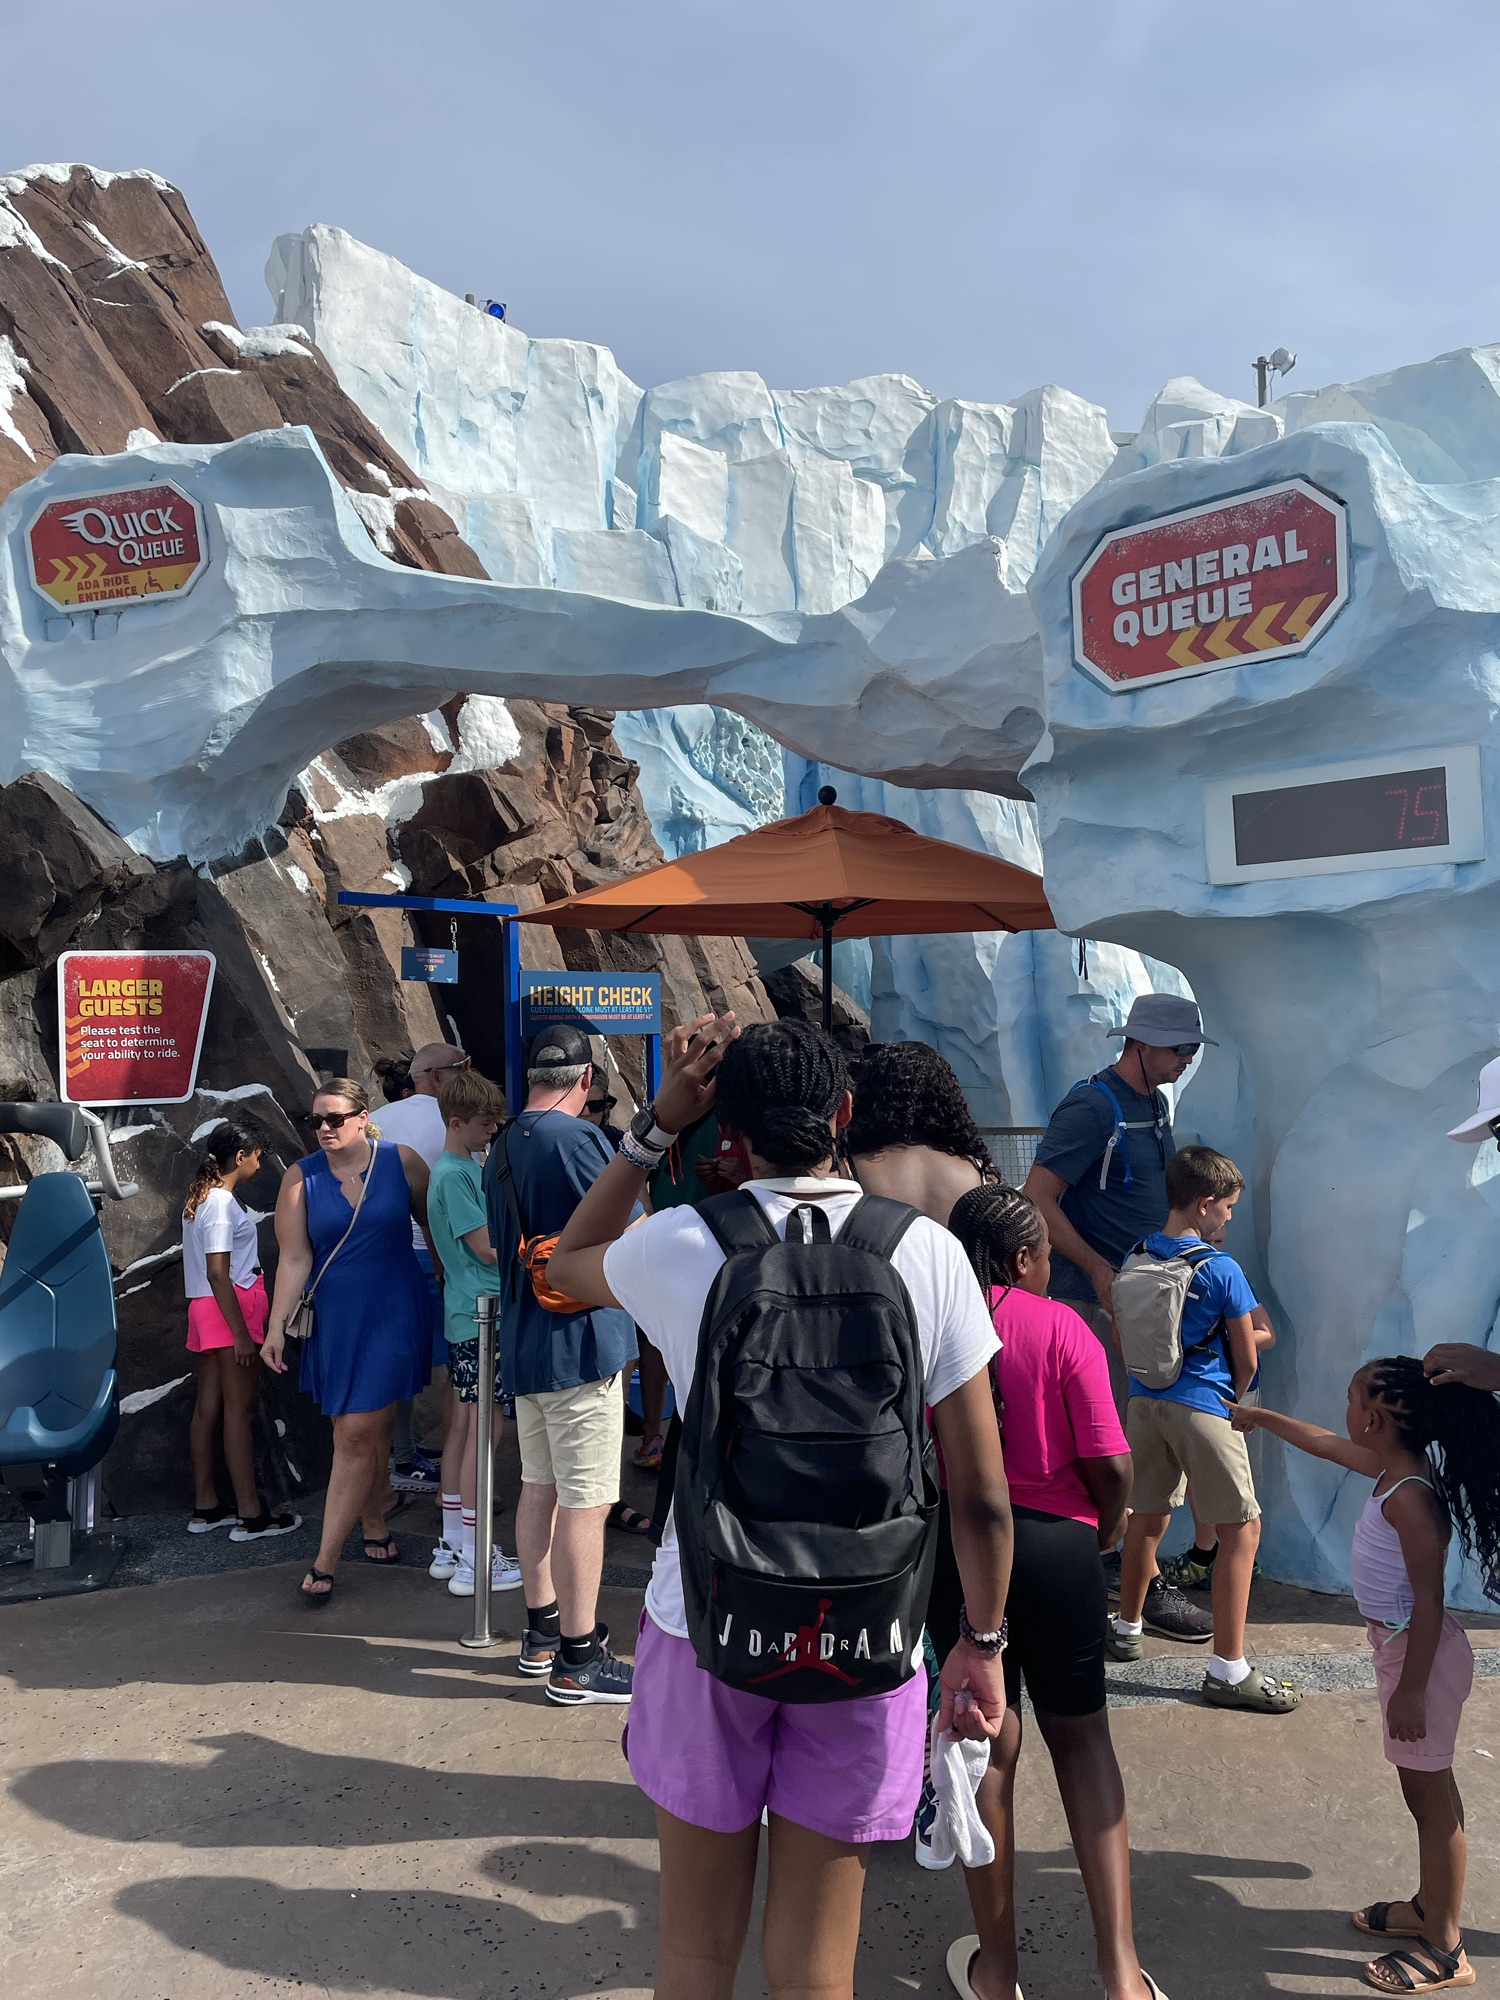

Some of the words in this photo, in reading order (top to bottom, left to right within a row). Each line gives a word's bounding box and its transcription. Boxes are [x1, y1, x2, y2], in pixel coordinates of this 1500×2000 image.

[118, 538, 185, 566] QUEUE
[1111, 529, 1308, 606] GENERAL
[77, 578, 100, 592] ADA
[103, 575, 130, 588] RIDE
[78, 586, 138, 604] ENTRANCE
[1113, 581, 1252, 647] QUEUE
[1384, 785, 1441, 841] 75
[78, 979, 163, 997] LARGER
[530, 986, 594, 1006] HEIGHT
[598, 986, 652, 1006] CHECK
[79, 998, 162, 1017] GUESTS
[530, 1006, 553, 1014] GUESTS
[80, 1026, 116, 1036] Please
[118, 1026, 140, 1035] test
[142, 1025, 160, 1034] the
[80, 1038, 104, 1048] seat
[107, 1038, 118, 1048] to
[120, 1037, 176, 1047] determine
[81, 1052, 106, 1062] your
[108, 1050, 141, 1060] ability
[144, 1050, 154, 1058] to
[158, 1048, 180, 1058] ride.
